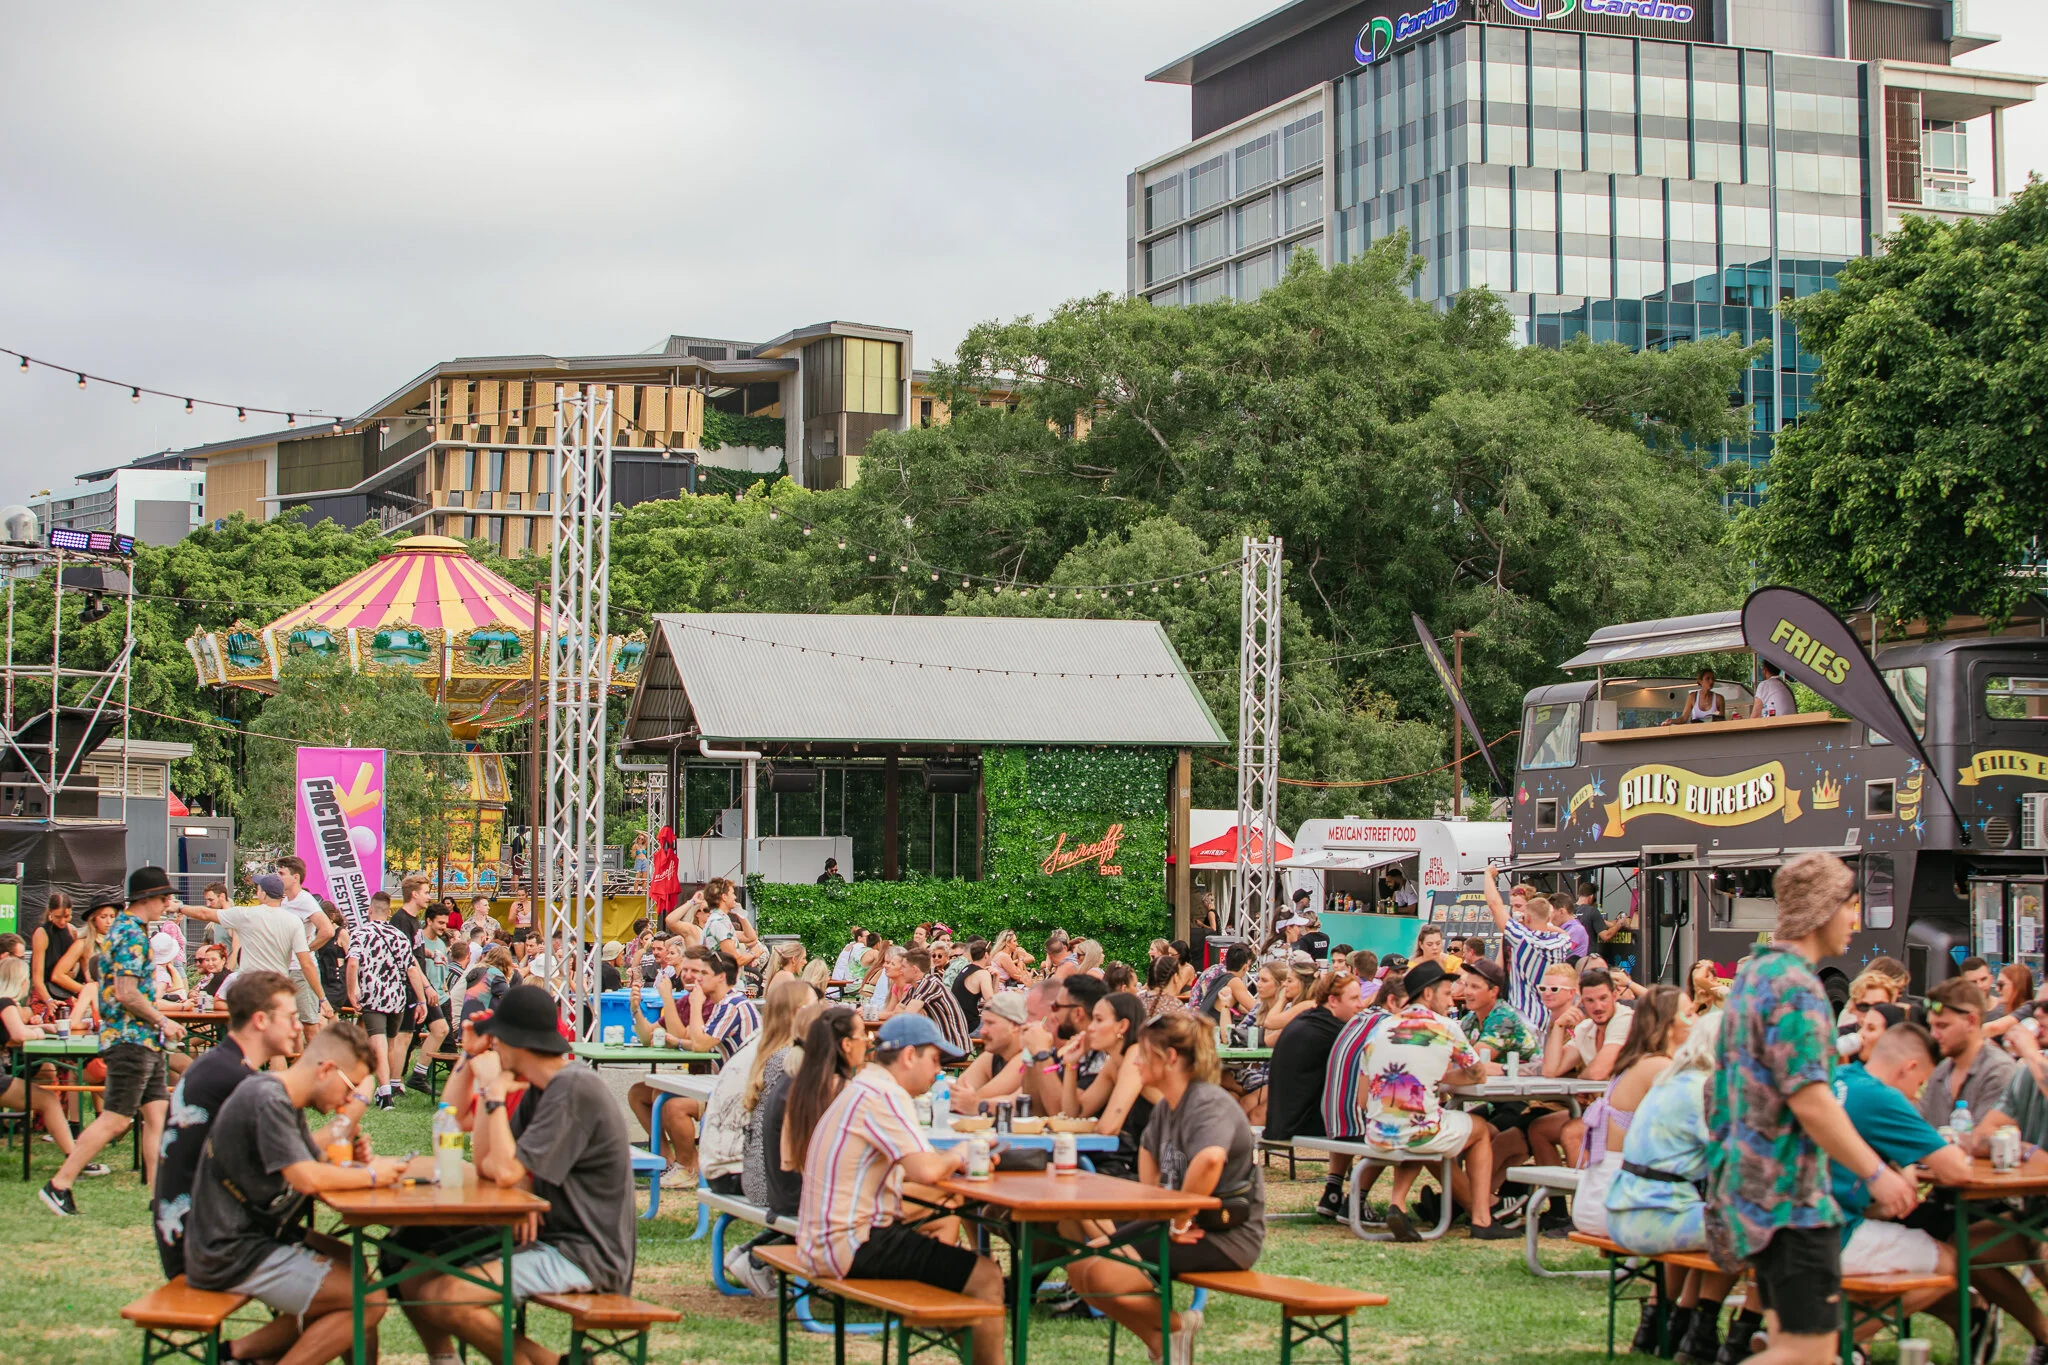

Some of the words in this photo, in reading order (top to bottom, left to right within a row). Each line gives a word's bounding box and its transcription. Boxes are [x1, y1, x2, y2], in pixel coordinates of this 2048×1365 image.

[1396, 0, 1457, 41] Cardno
[1582, 0, 1692, 23] Cardno
[1769, 617, 1851, 685] FRIES
[1621, 773, 1680, 811] BILL'S
[1684, 772, 1775, 815] BURGERS
[306, 779, 357, 870] FACTORY
[1328, 826, 1362, 841] MEXICAN
[1364, 827, 1391, 842] STREET
[1392, 827, 1417, 842] FOOD
[1040, 823, 1125, 875] Smirnoff
[1099, 865, 1123, 876] BAR
[332, 876, 358, 935] FESTIVA
